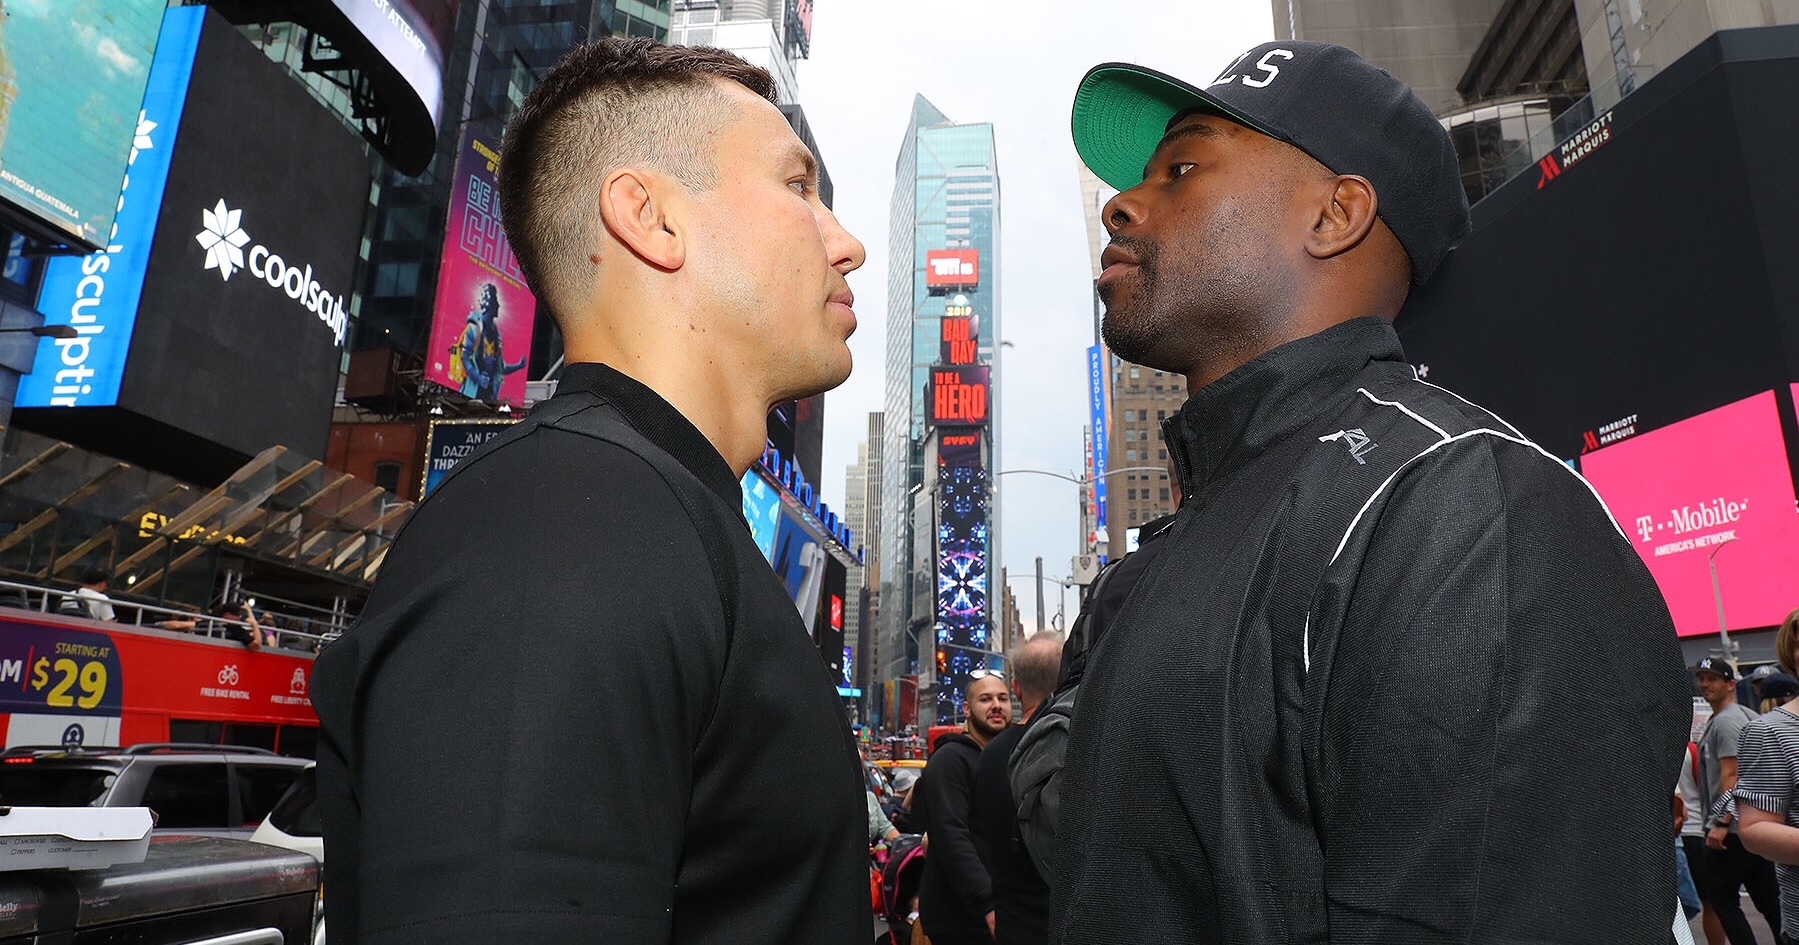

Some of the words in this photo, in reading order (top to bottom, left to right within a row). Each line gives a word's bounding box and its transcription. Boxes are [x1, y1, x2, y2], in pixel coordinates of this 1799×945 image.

[388, 8, 427, 56] ATTEMPT
[1561, 111, 1613, 155] MARRIOTT
[1563, 129, 1609, 167] MARQUIS
[0, 170, 35, 195] ANTIGUA
[35, 189, 79, 219] GUATEMALA
[467, 174, 491, 212] BE
[946, 306, 972, 316] 2019
[943, 318, 969, 341] BAD
[951, 340, 976, 363] DAY
[934, 372, 944, 384] TO
[945, 372, 953, 384] BE
[954, 372, 960, 384] A
[1092, 352, 1101, 410] PROUDLY
[934, 384, 985, 421] HERO
[1599, 413, 1638, 435] MARRIOTT
[1600, 425, 1635, 444] MARQUIS
[1095, 418, 1106, 485] AMERICAN
[1654, 538, 1695, 557] AMERICA'S
[1695, 530, 1737, 548] NETWORK
[55, 642, 98, 657] STARTING
[98, 647, 110, 658] AT
[0, 659, 22, 682] M
[31, 656, 107, 709] $29
[200, 687, 215, 697] FREE
[215, 688, 229, 698] BIKE
[229, 689, 250, 700] RENTAL
